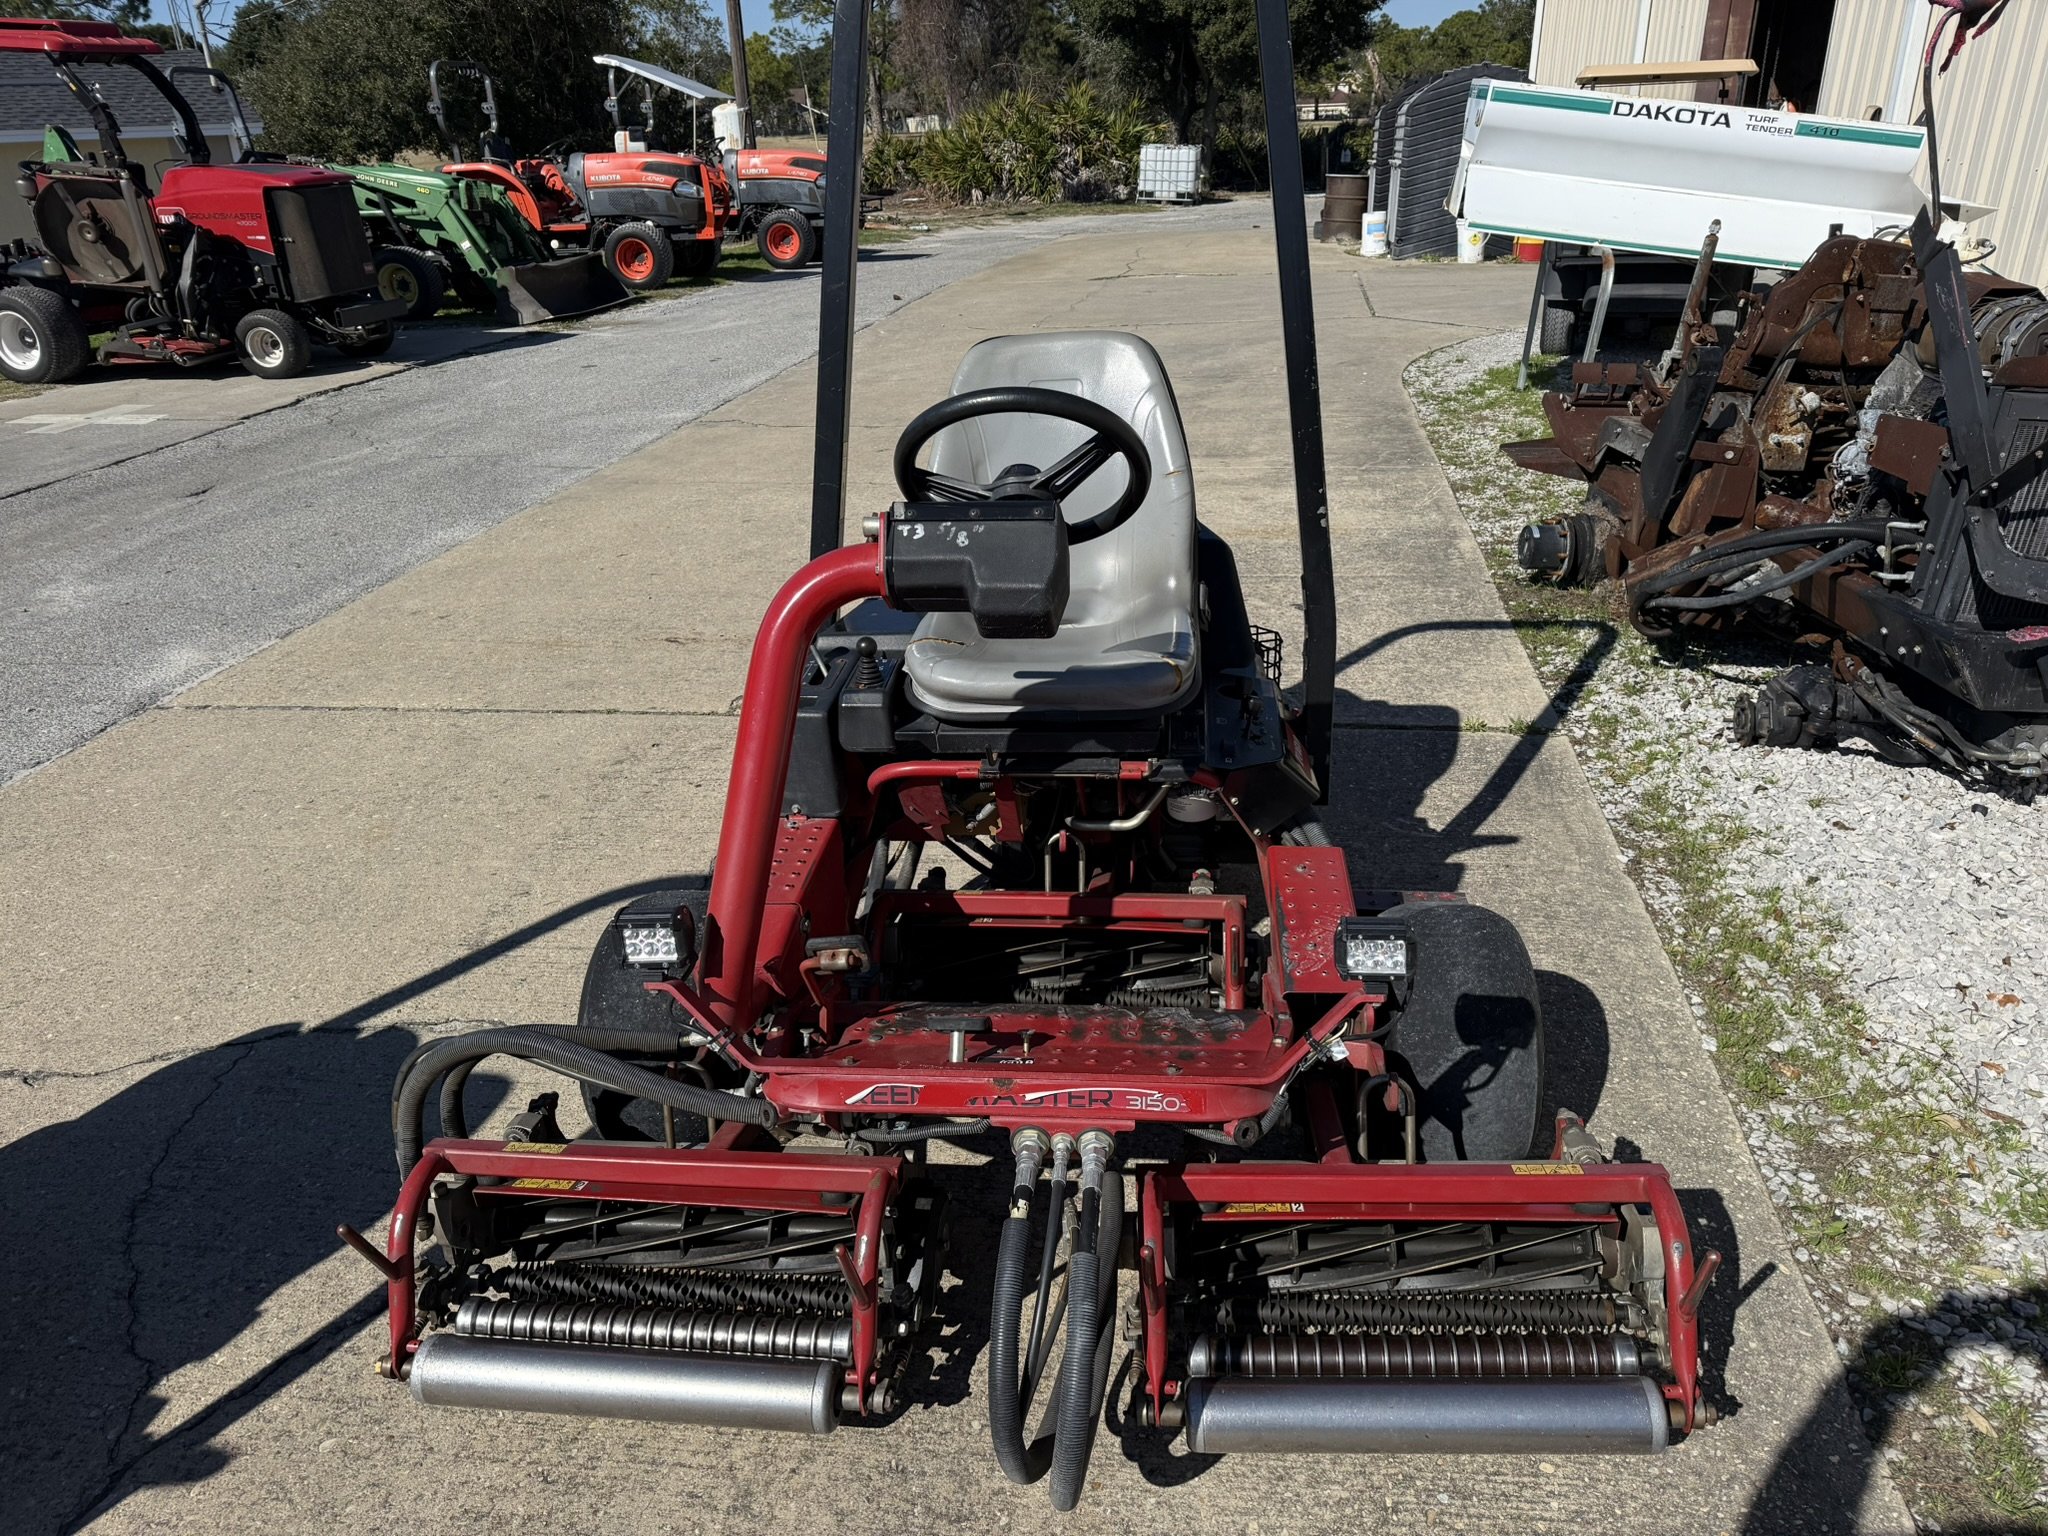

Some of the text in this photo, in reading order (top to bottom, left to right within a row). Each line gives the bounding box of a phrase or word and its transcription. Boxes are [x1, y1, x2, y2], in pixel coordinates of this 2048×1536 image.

[1613, 101, 1731, 128] DAKOTA
[1748, 114, 1779, 124] TURF
[1745, 123, 1793, 135] TENDER
[1810, 126, 1840, 136] 410
[356, 174, 398, 187] JOHN DEERE
[590, 174, 621, 182] KUBOTA
[897, 523, 925, 540] T3
